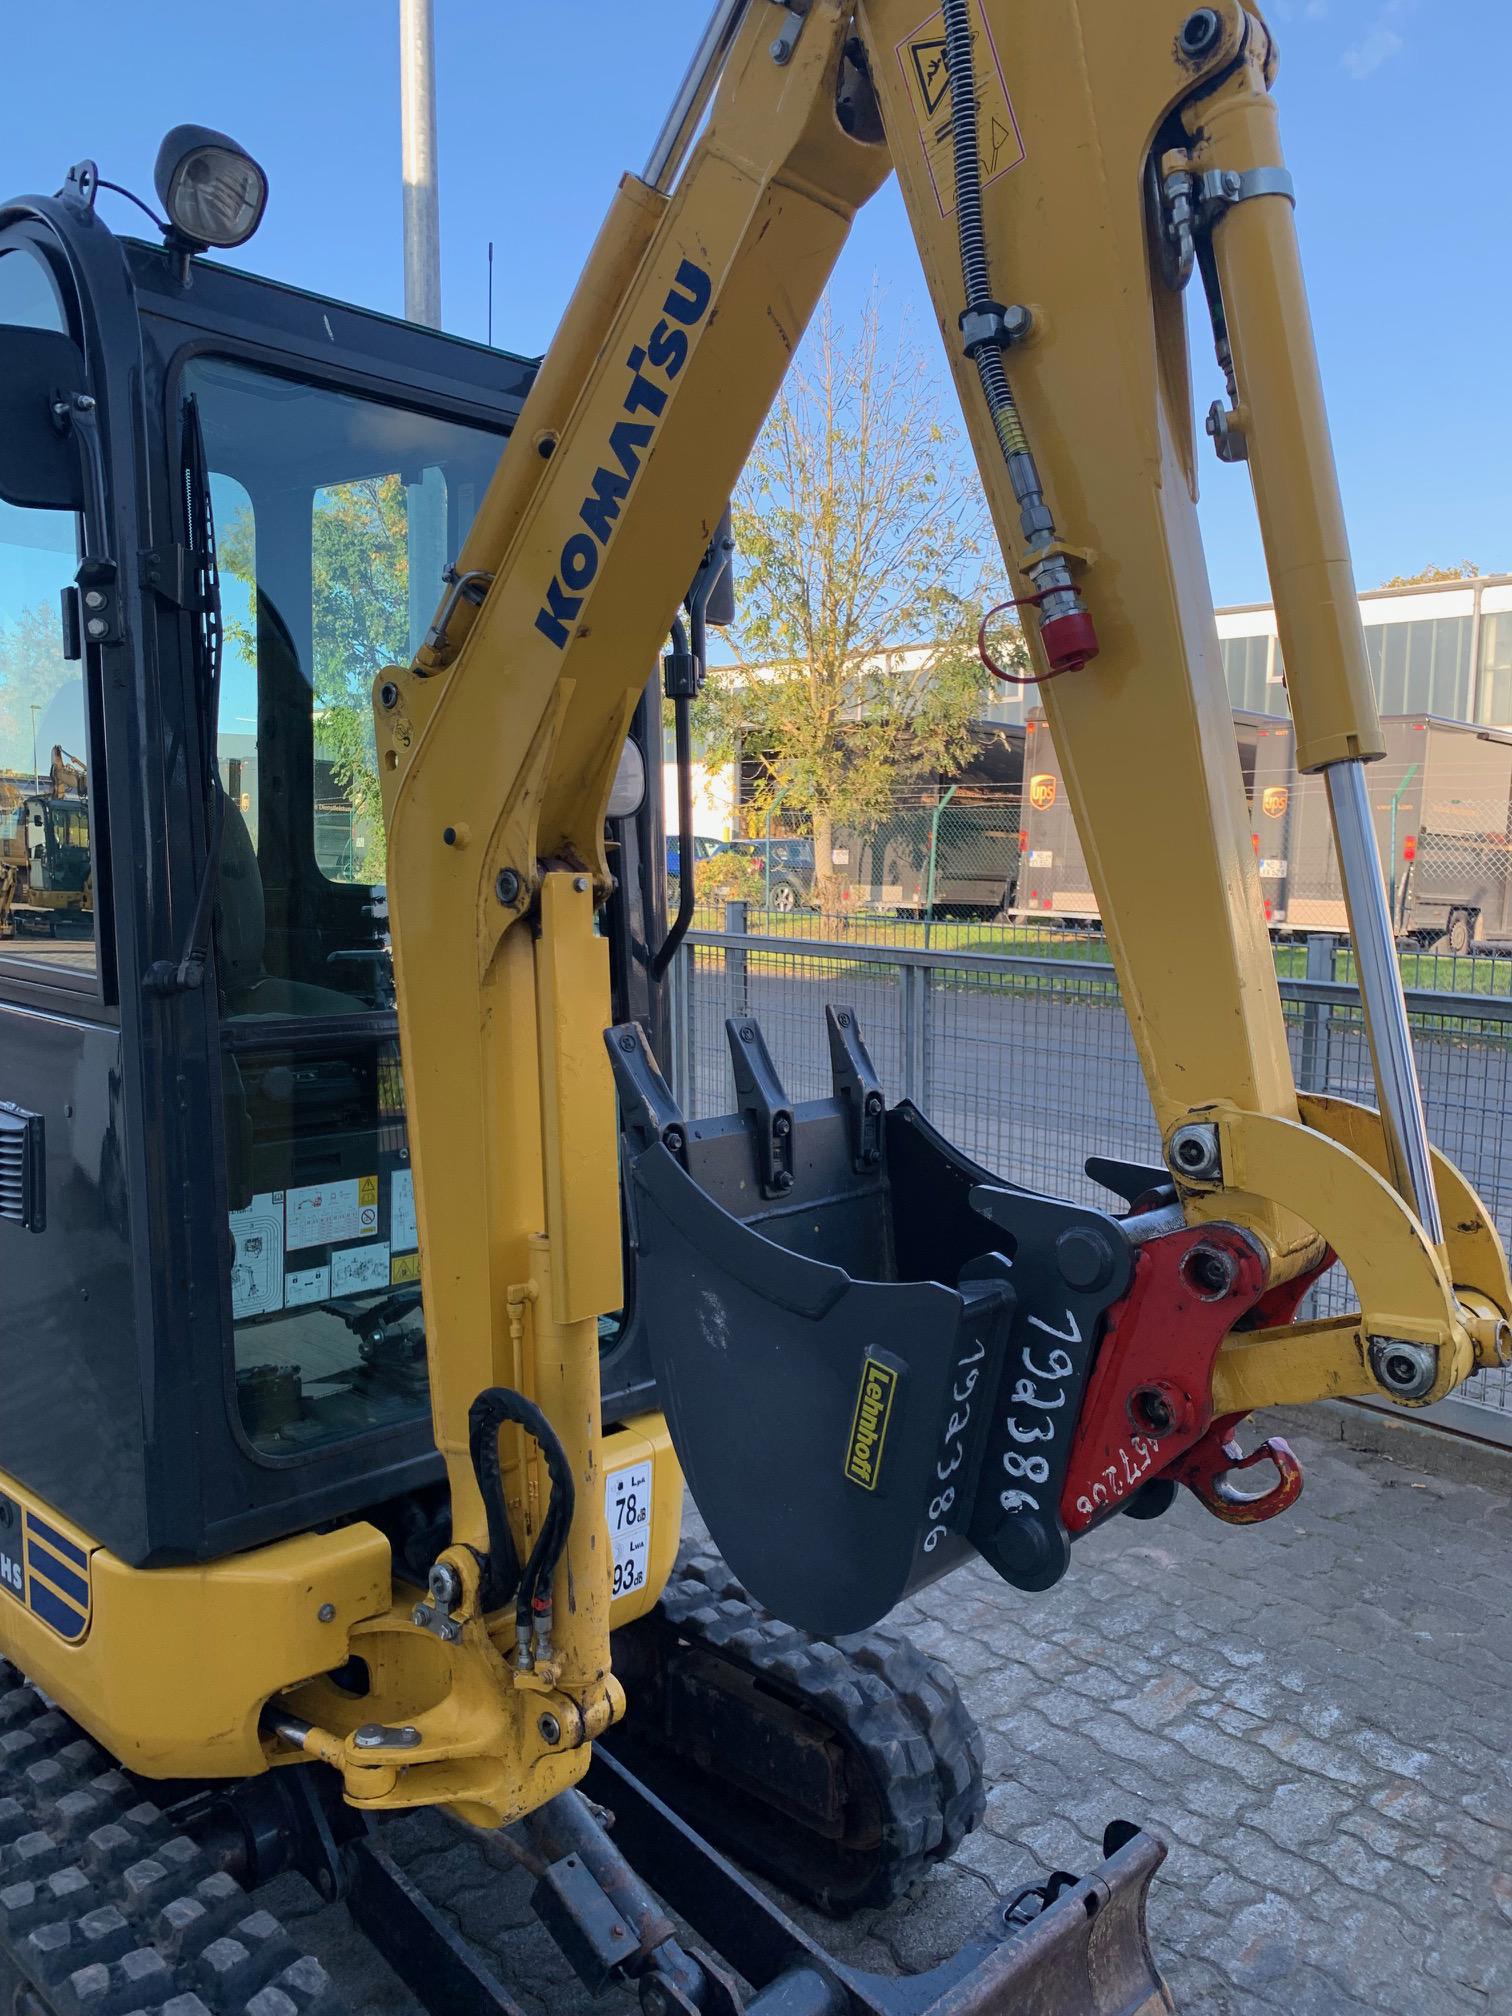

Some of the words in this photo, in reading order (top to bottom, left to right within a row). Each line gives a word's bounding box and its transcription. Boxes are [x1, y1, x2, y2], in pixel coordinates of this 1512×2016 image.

[534, 258, 711, 650] KOMATSU
[1031, 785, 1054, 805] ups
[1265, 796, 1286, 813] ups
[850, 1366, 890, 1482] Lehnhoff
[923, 1338, 985, 1552] 192386
[999, 1308, 1082, 1513] 192386
[0, 1552, 22, 1590] HS
